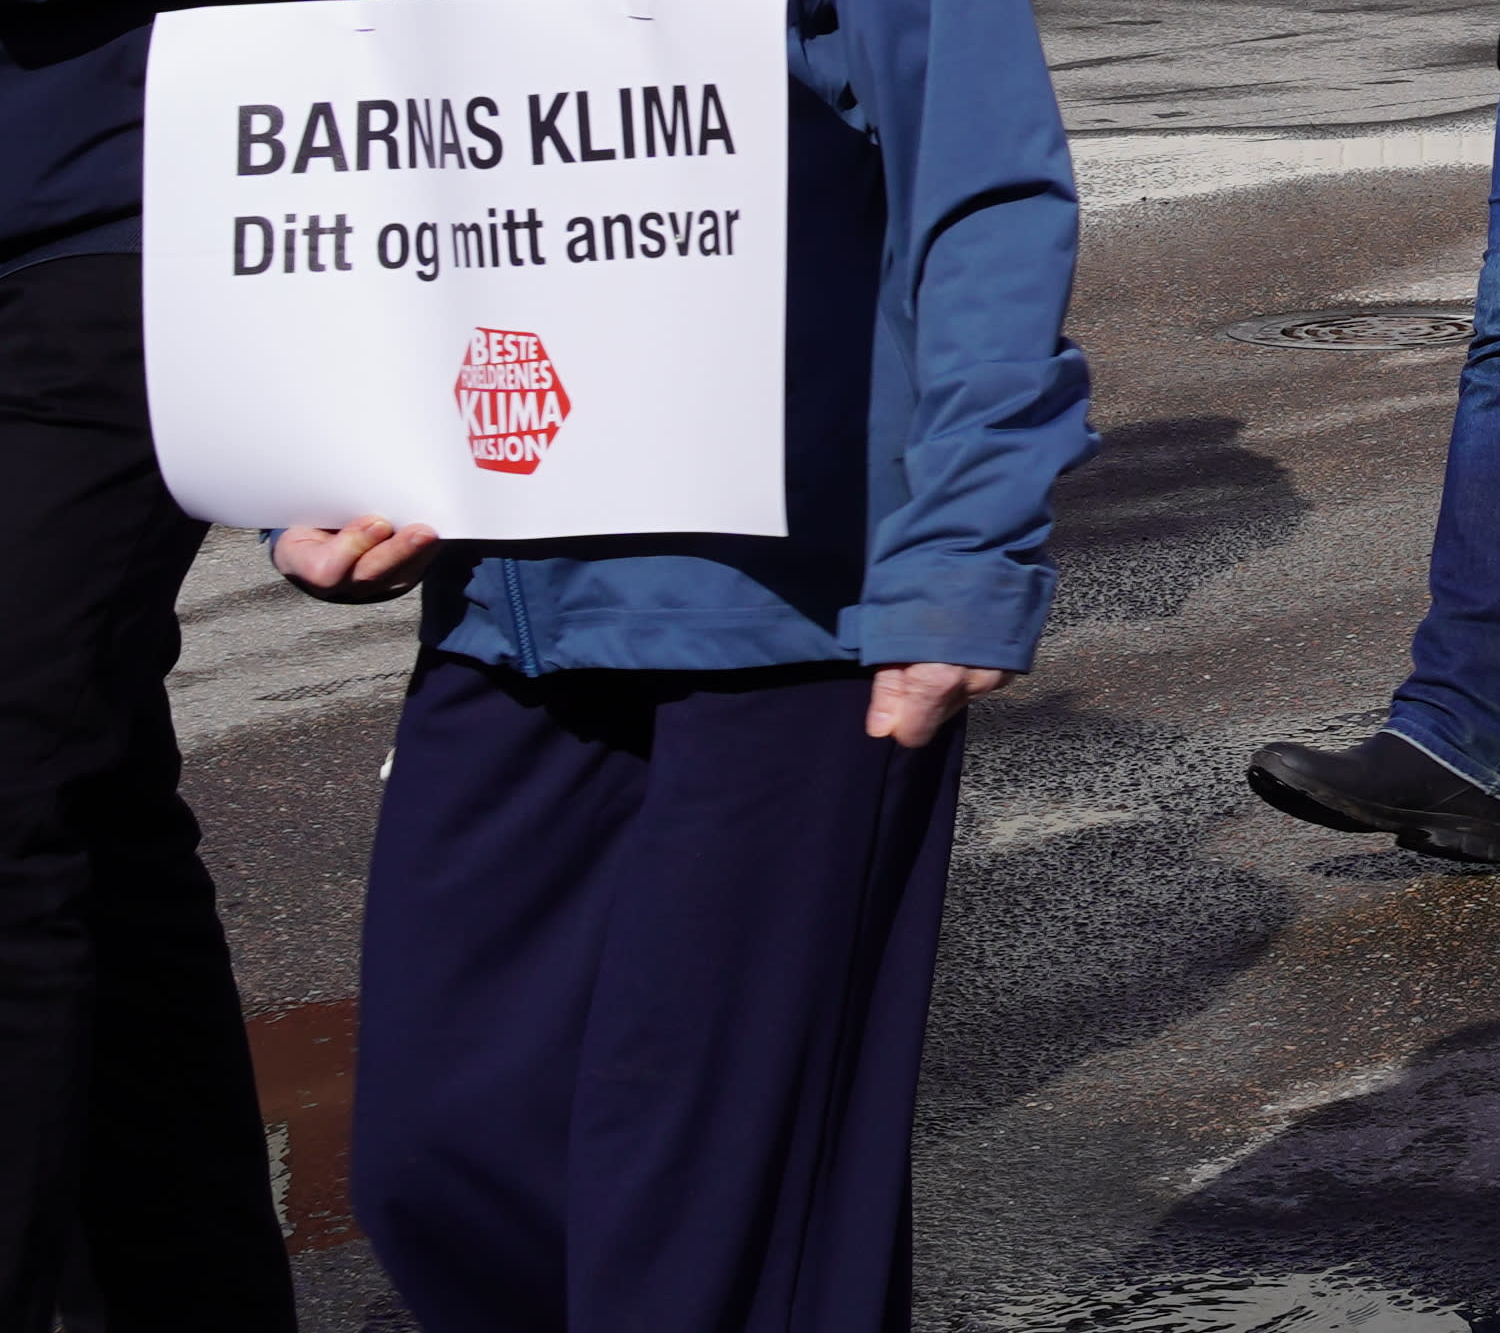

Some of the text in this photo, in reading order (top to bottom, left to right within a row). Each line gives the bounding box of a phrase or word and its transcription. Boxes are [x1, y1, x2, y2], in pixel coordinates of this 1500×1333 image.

[235, 83, 737, 177] BARNAS KLIMA
[232, 206, 741, 283] Ditt og mitt ansvar
[471, 332, 540, 365] BESTE
[462, 389, 563, 436] KLIMA
[472, 432, 550, 463] AKSJON
